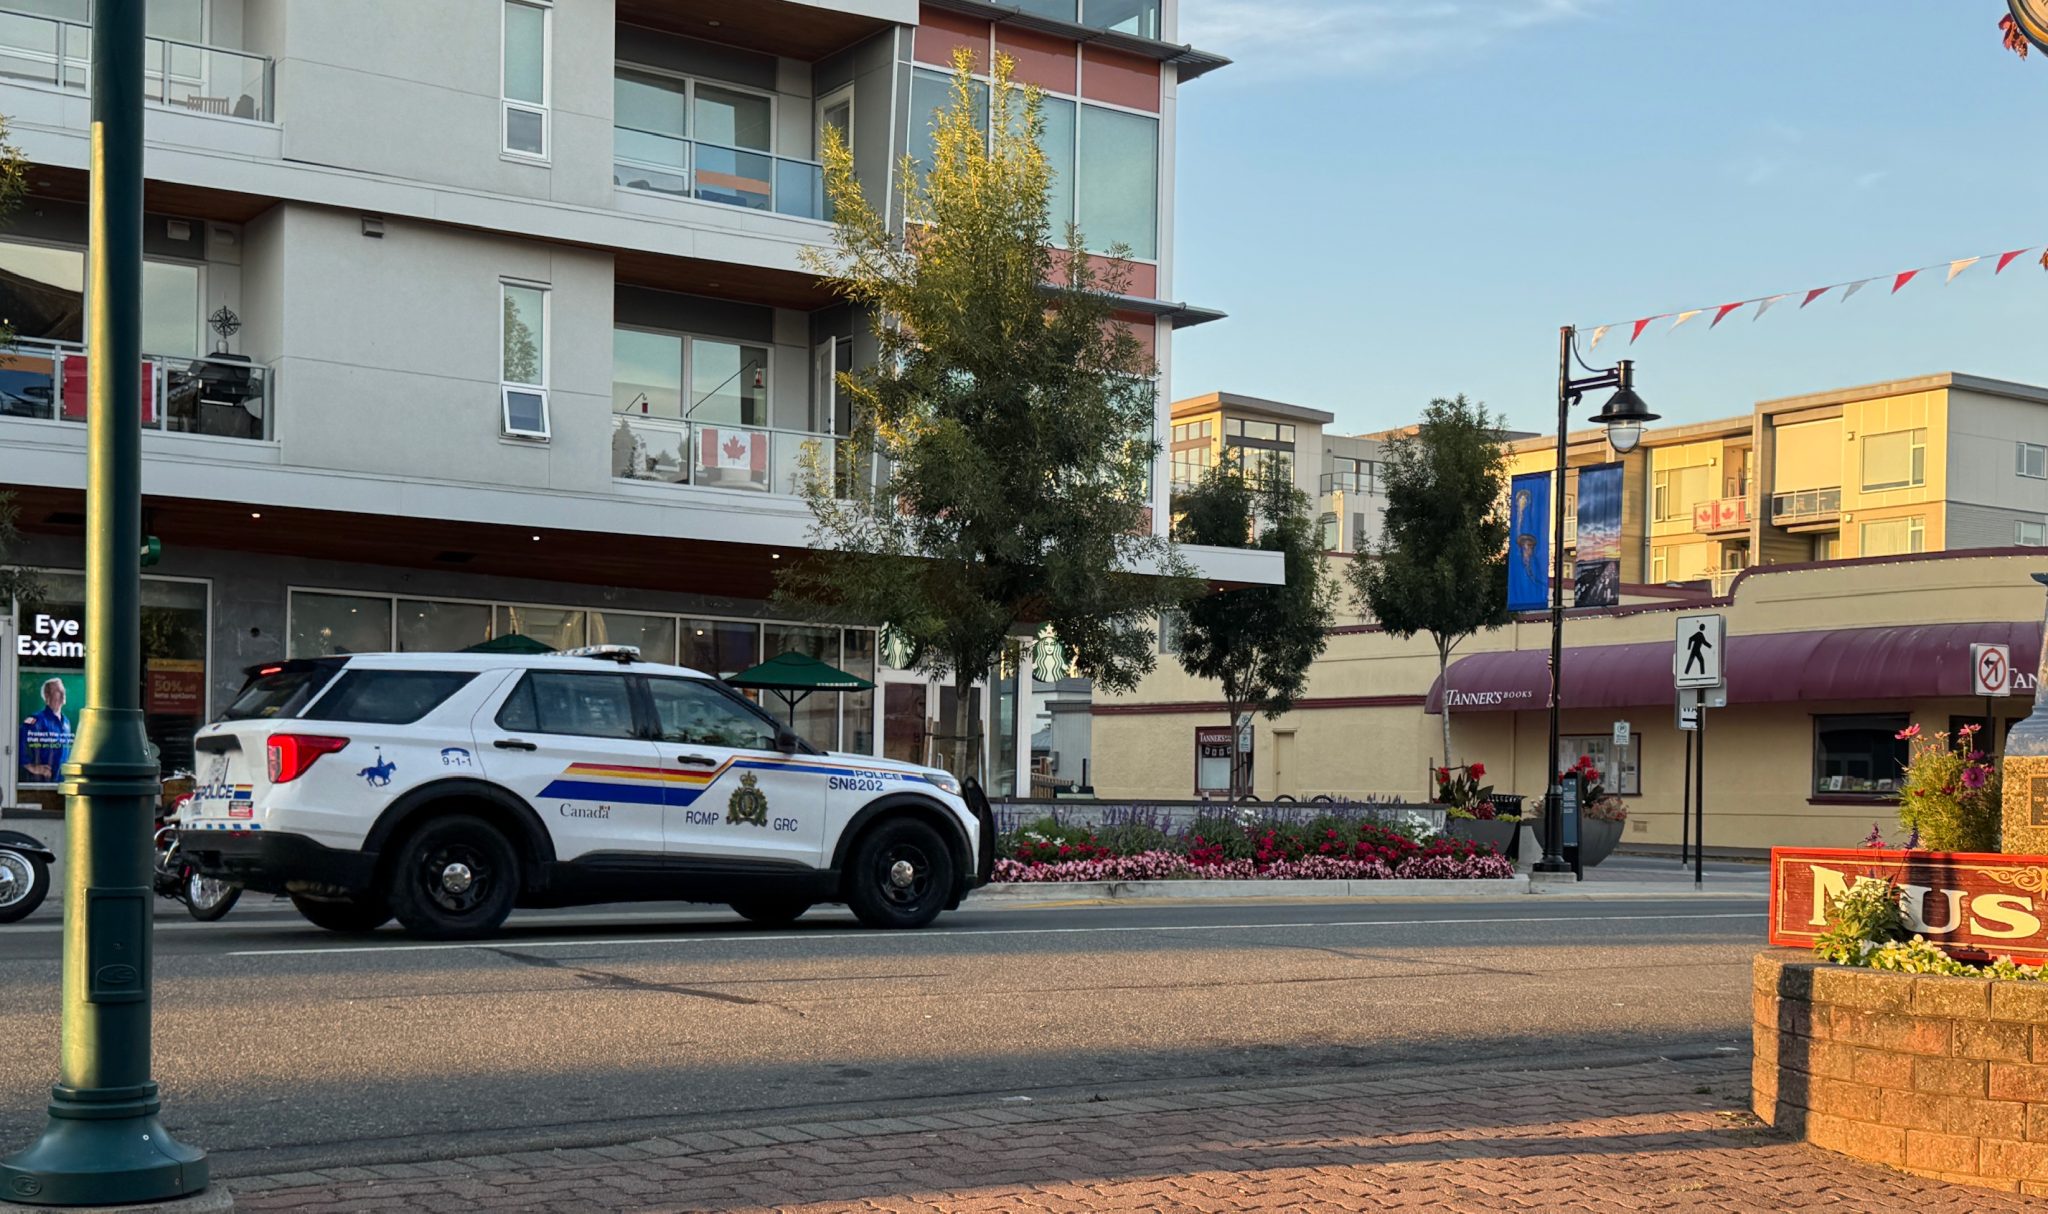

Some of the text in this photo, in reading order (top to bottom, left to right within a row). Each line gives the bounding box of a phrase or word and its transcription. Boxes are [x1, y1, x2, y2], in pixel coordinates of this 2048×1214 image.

[36, 614, 80, 640] Eye
[17, 635, 86, 658] Exam
[154, 680, 183, 692] 50%
[1446, 689, 1533, 706] TANNER'S BOOKS
[441, 756, 473, 767] 9-1-1
[855, 769, 902, 781] POLICE
[201, 784, 235, 800] POLICE
[829, 776, 884, 792] SN8202
[560, 803, 610, 820] Canada
[685, 810, 720, 826] RCMP
[773, 817, 799, 832] GRC
